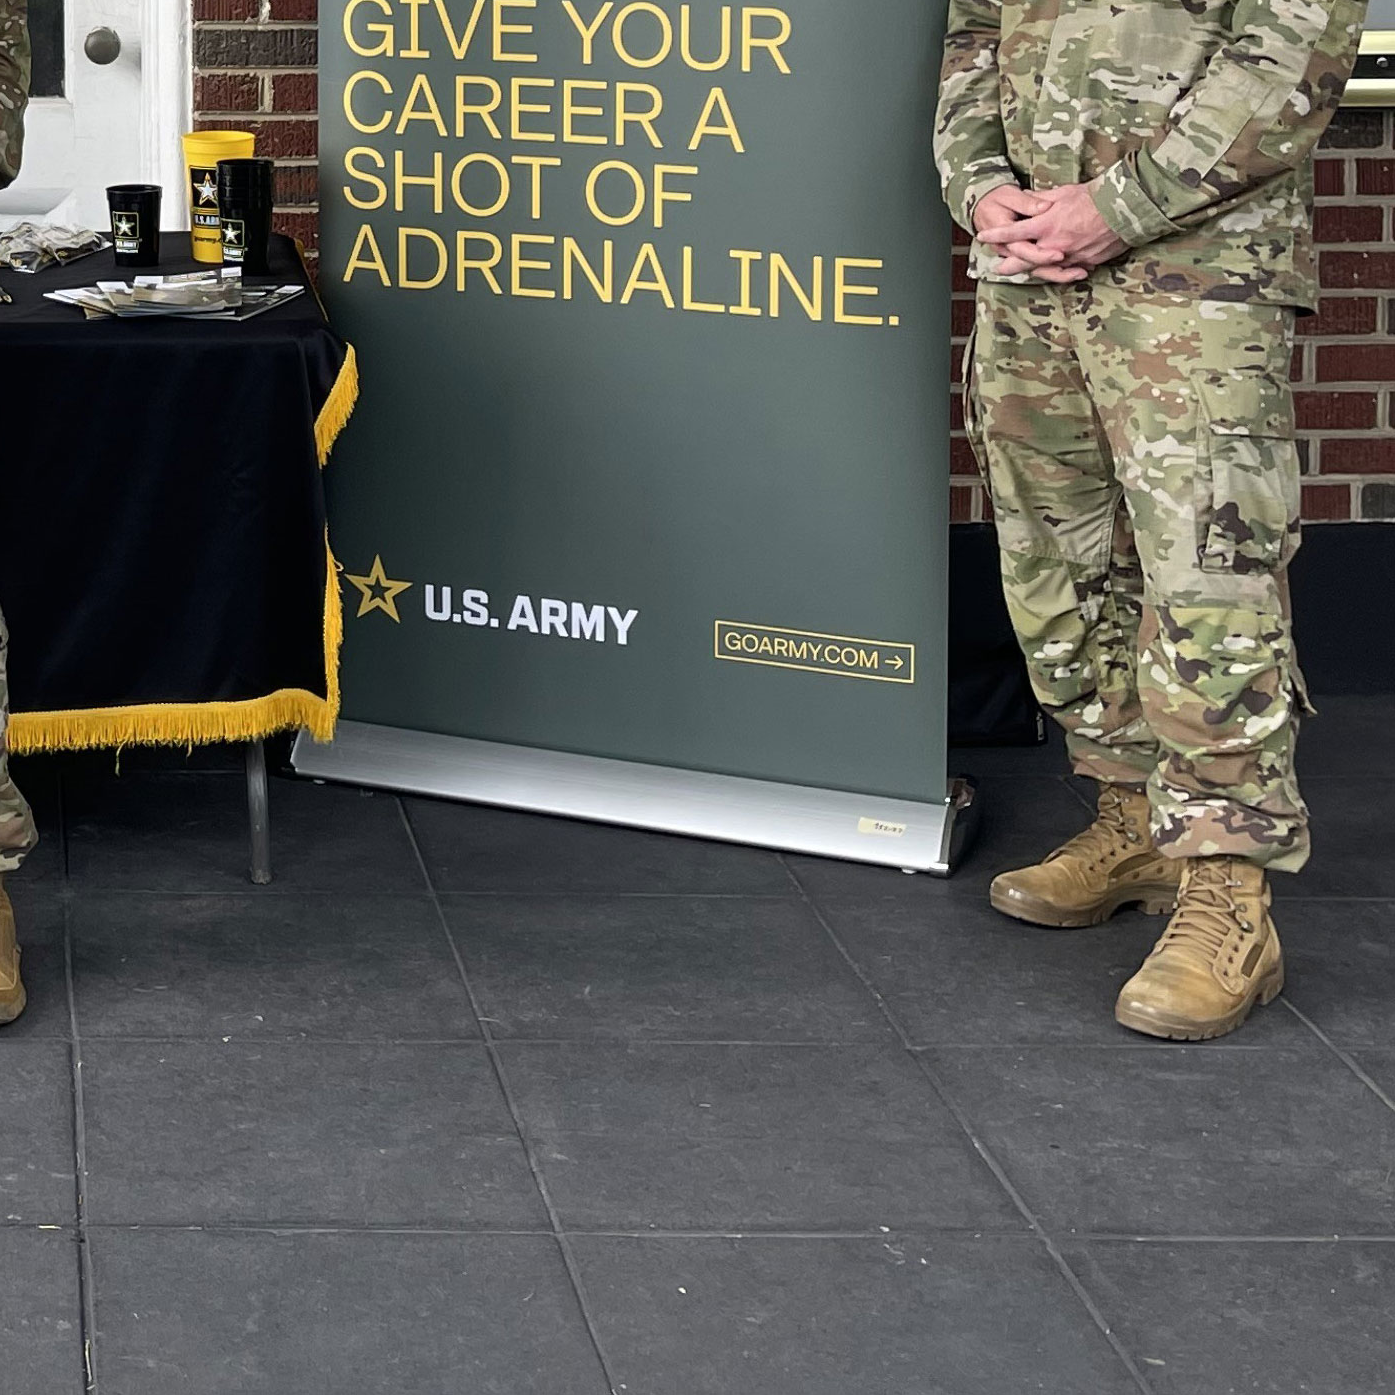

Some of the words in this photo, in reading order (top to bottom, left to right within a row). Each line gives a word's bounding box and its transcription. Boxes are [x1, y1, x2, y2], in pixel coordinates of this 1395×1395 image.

[561, 0, 792, 74] YOUR
[343, 70, 663, 148] CAREER
[688, 86, 745, 153] A
[343, 146, 562, 219] SHOT
[585, 159, 699, 228] OF
[342, 224, 900, 326] ADRENALINE.
[424, 584, 500, 628] U.S.
[506, 596, 639, 645] ARMY
[724, 631, 880, 671] GOARMY.COM
